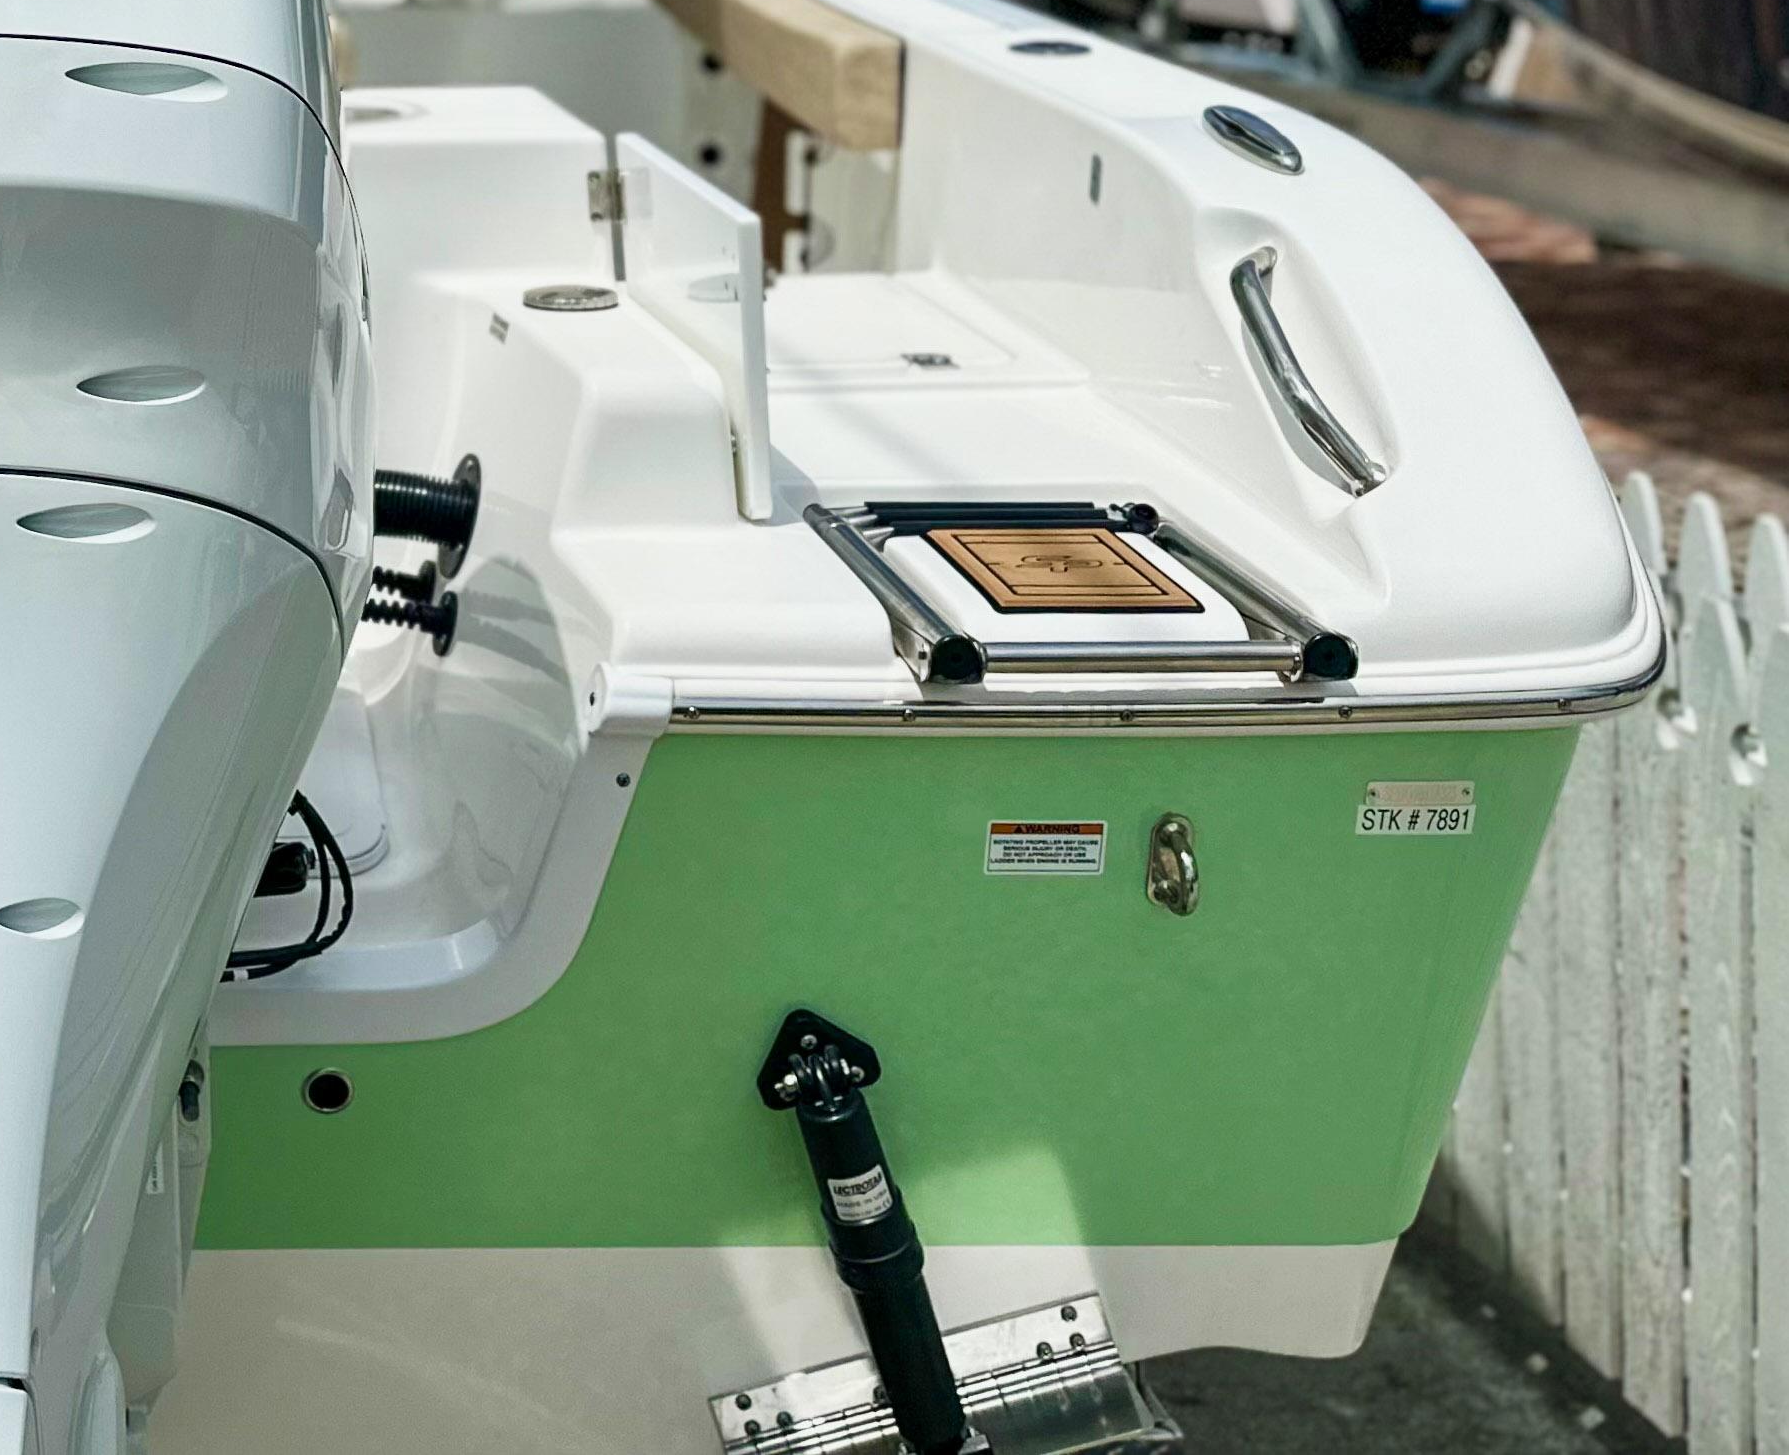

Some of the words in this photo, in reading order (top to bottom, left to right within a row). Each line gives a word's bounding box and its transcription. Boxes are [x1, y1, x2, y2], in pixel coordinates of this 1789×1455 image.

[1362, 808, 1402, 830] STK
[1408, 808, 1420, 830] #
[1426, 808, 1469, 830] 7891
[1025, 824, 1080, 834] WARNING
